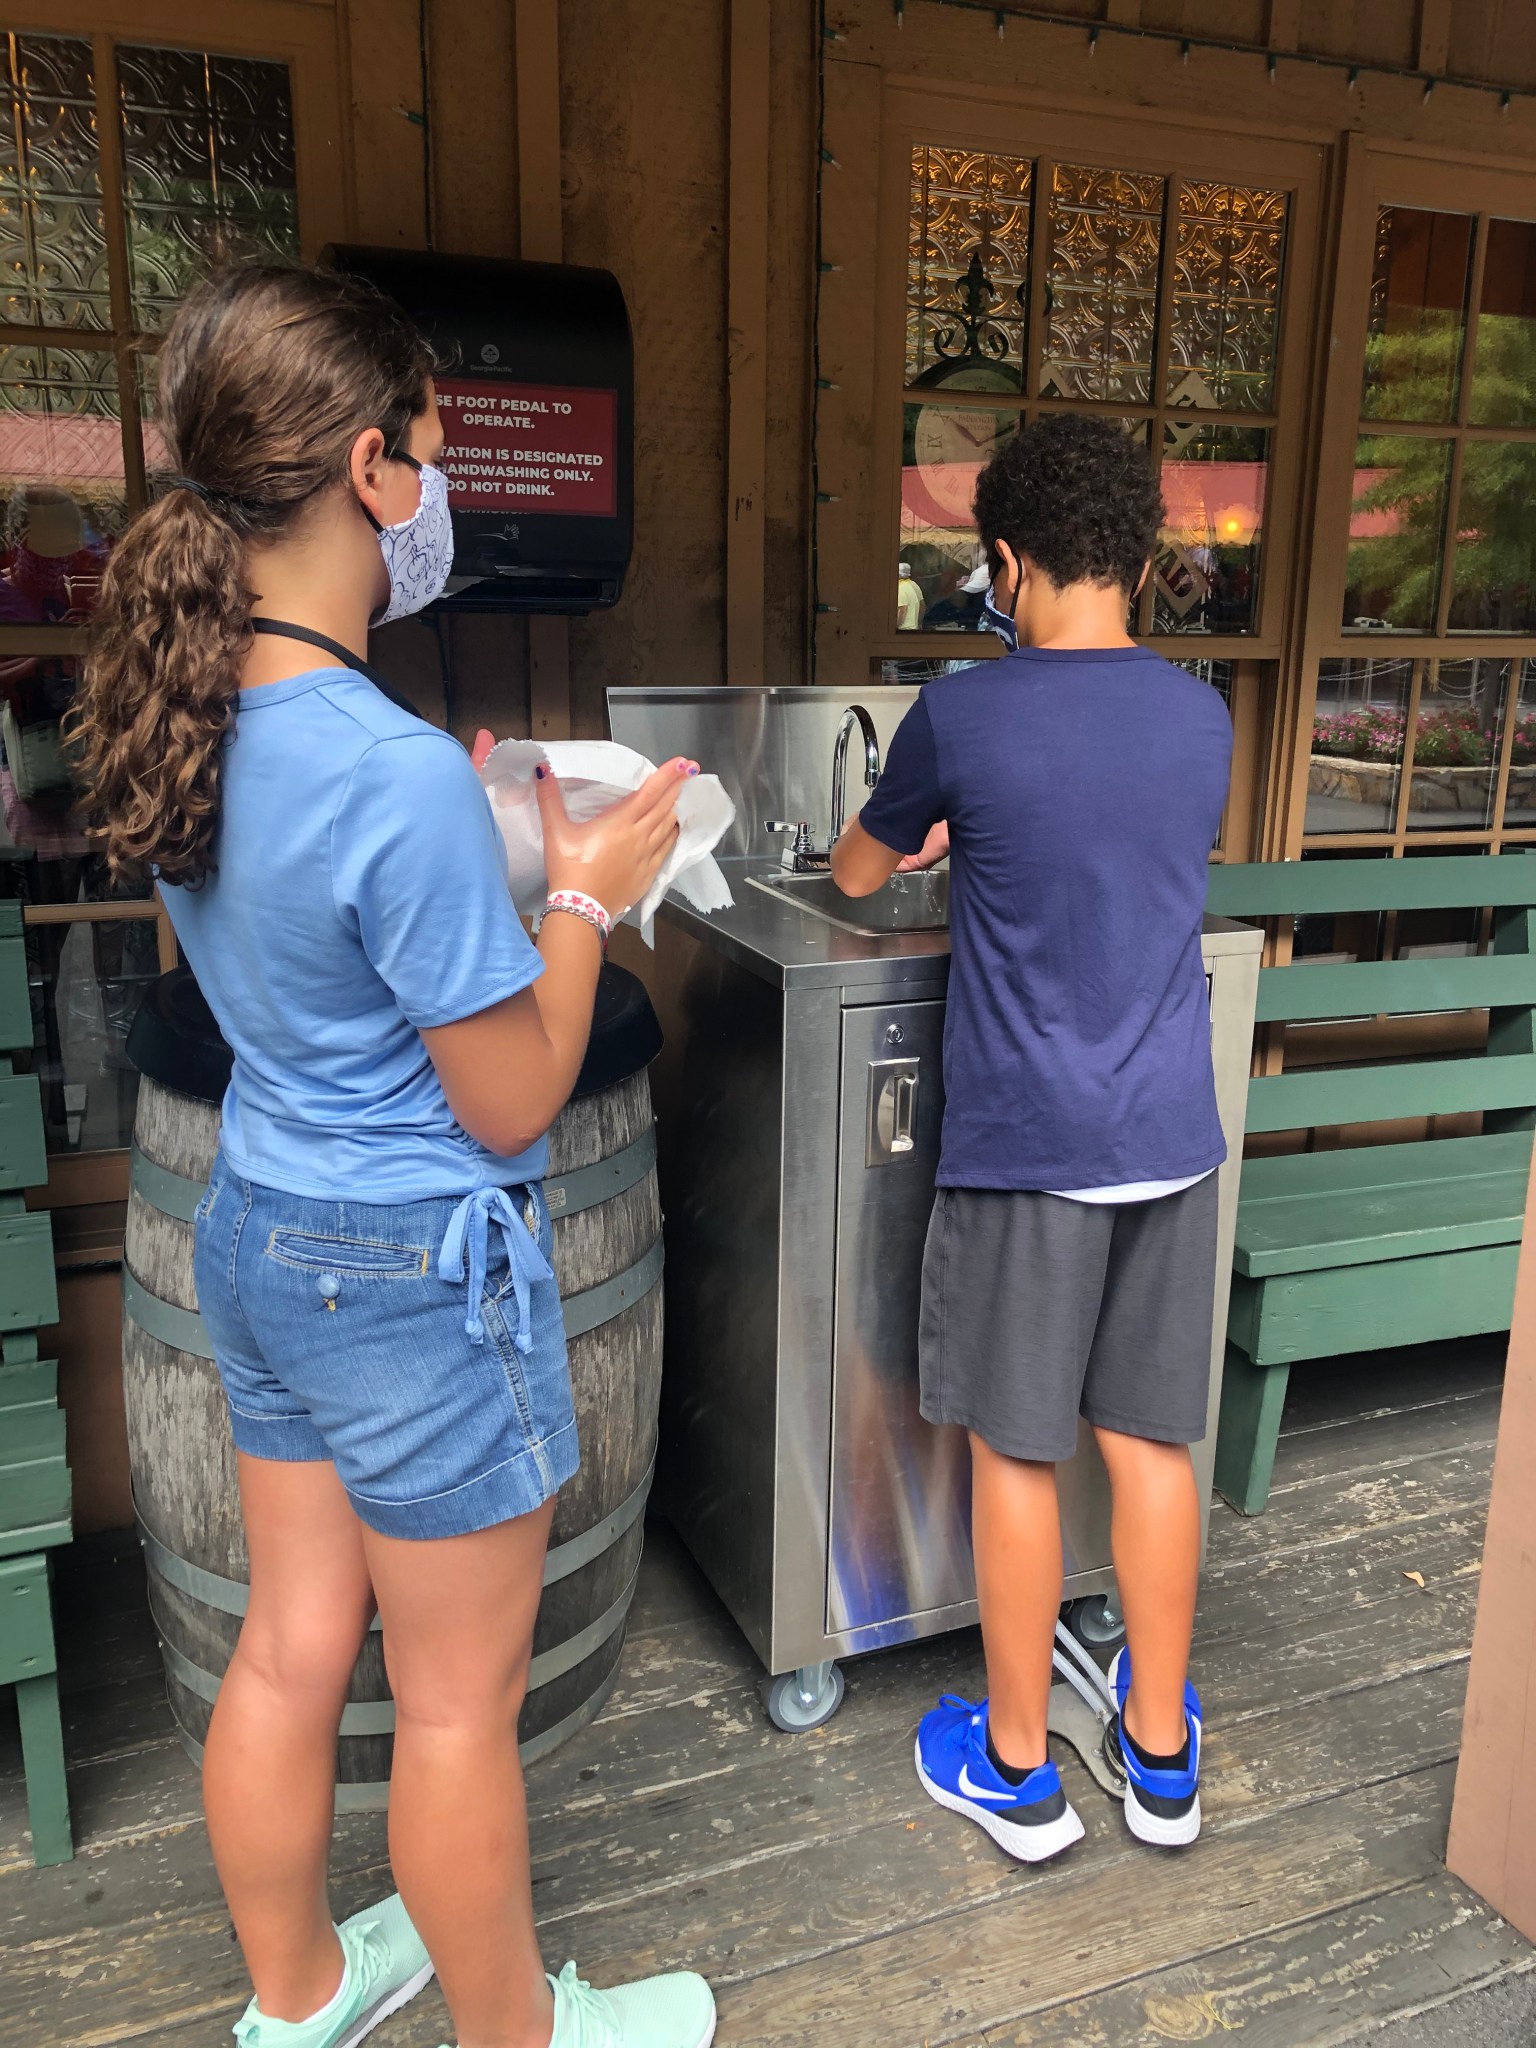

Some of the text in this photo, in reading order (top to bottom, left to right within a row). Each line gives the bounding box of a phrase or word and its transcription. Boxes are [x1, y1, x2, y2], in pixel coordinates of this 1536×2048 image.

[435, 394, 572, 415] SE FOOT PEDAL TO
[462, 413, 536, 429] OPERATE.
[440, 446, 604, 466] TATION IS DESIGNATED
[553, 469, 594, 481] ONLY.
[471, 481, 502, 494] NOT
[505, 483, 555, 496] DRINK.
